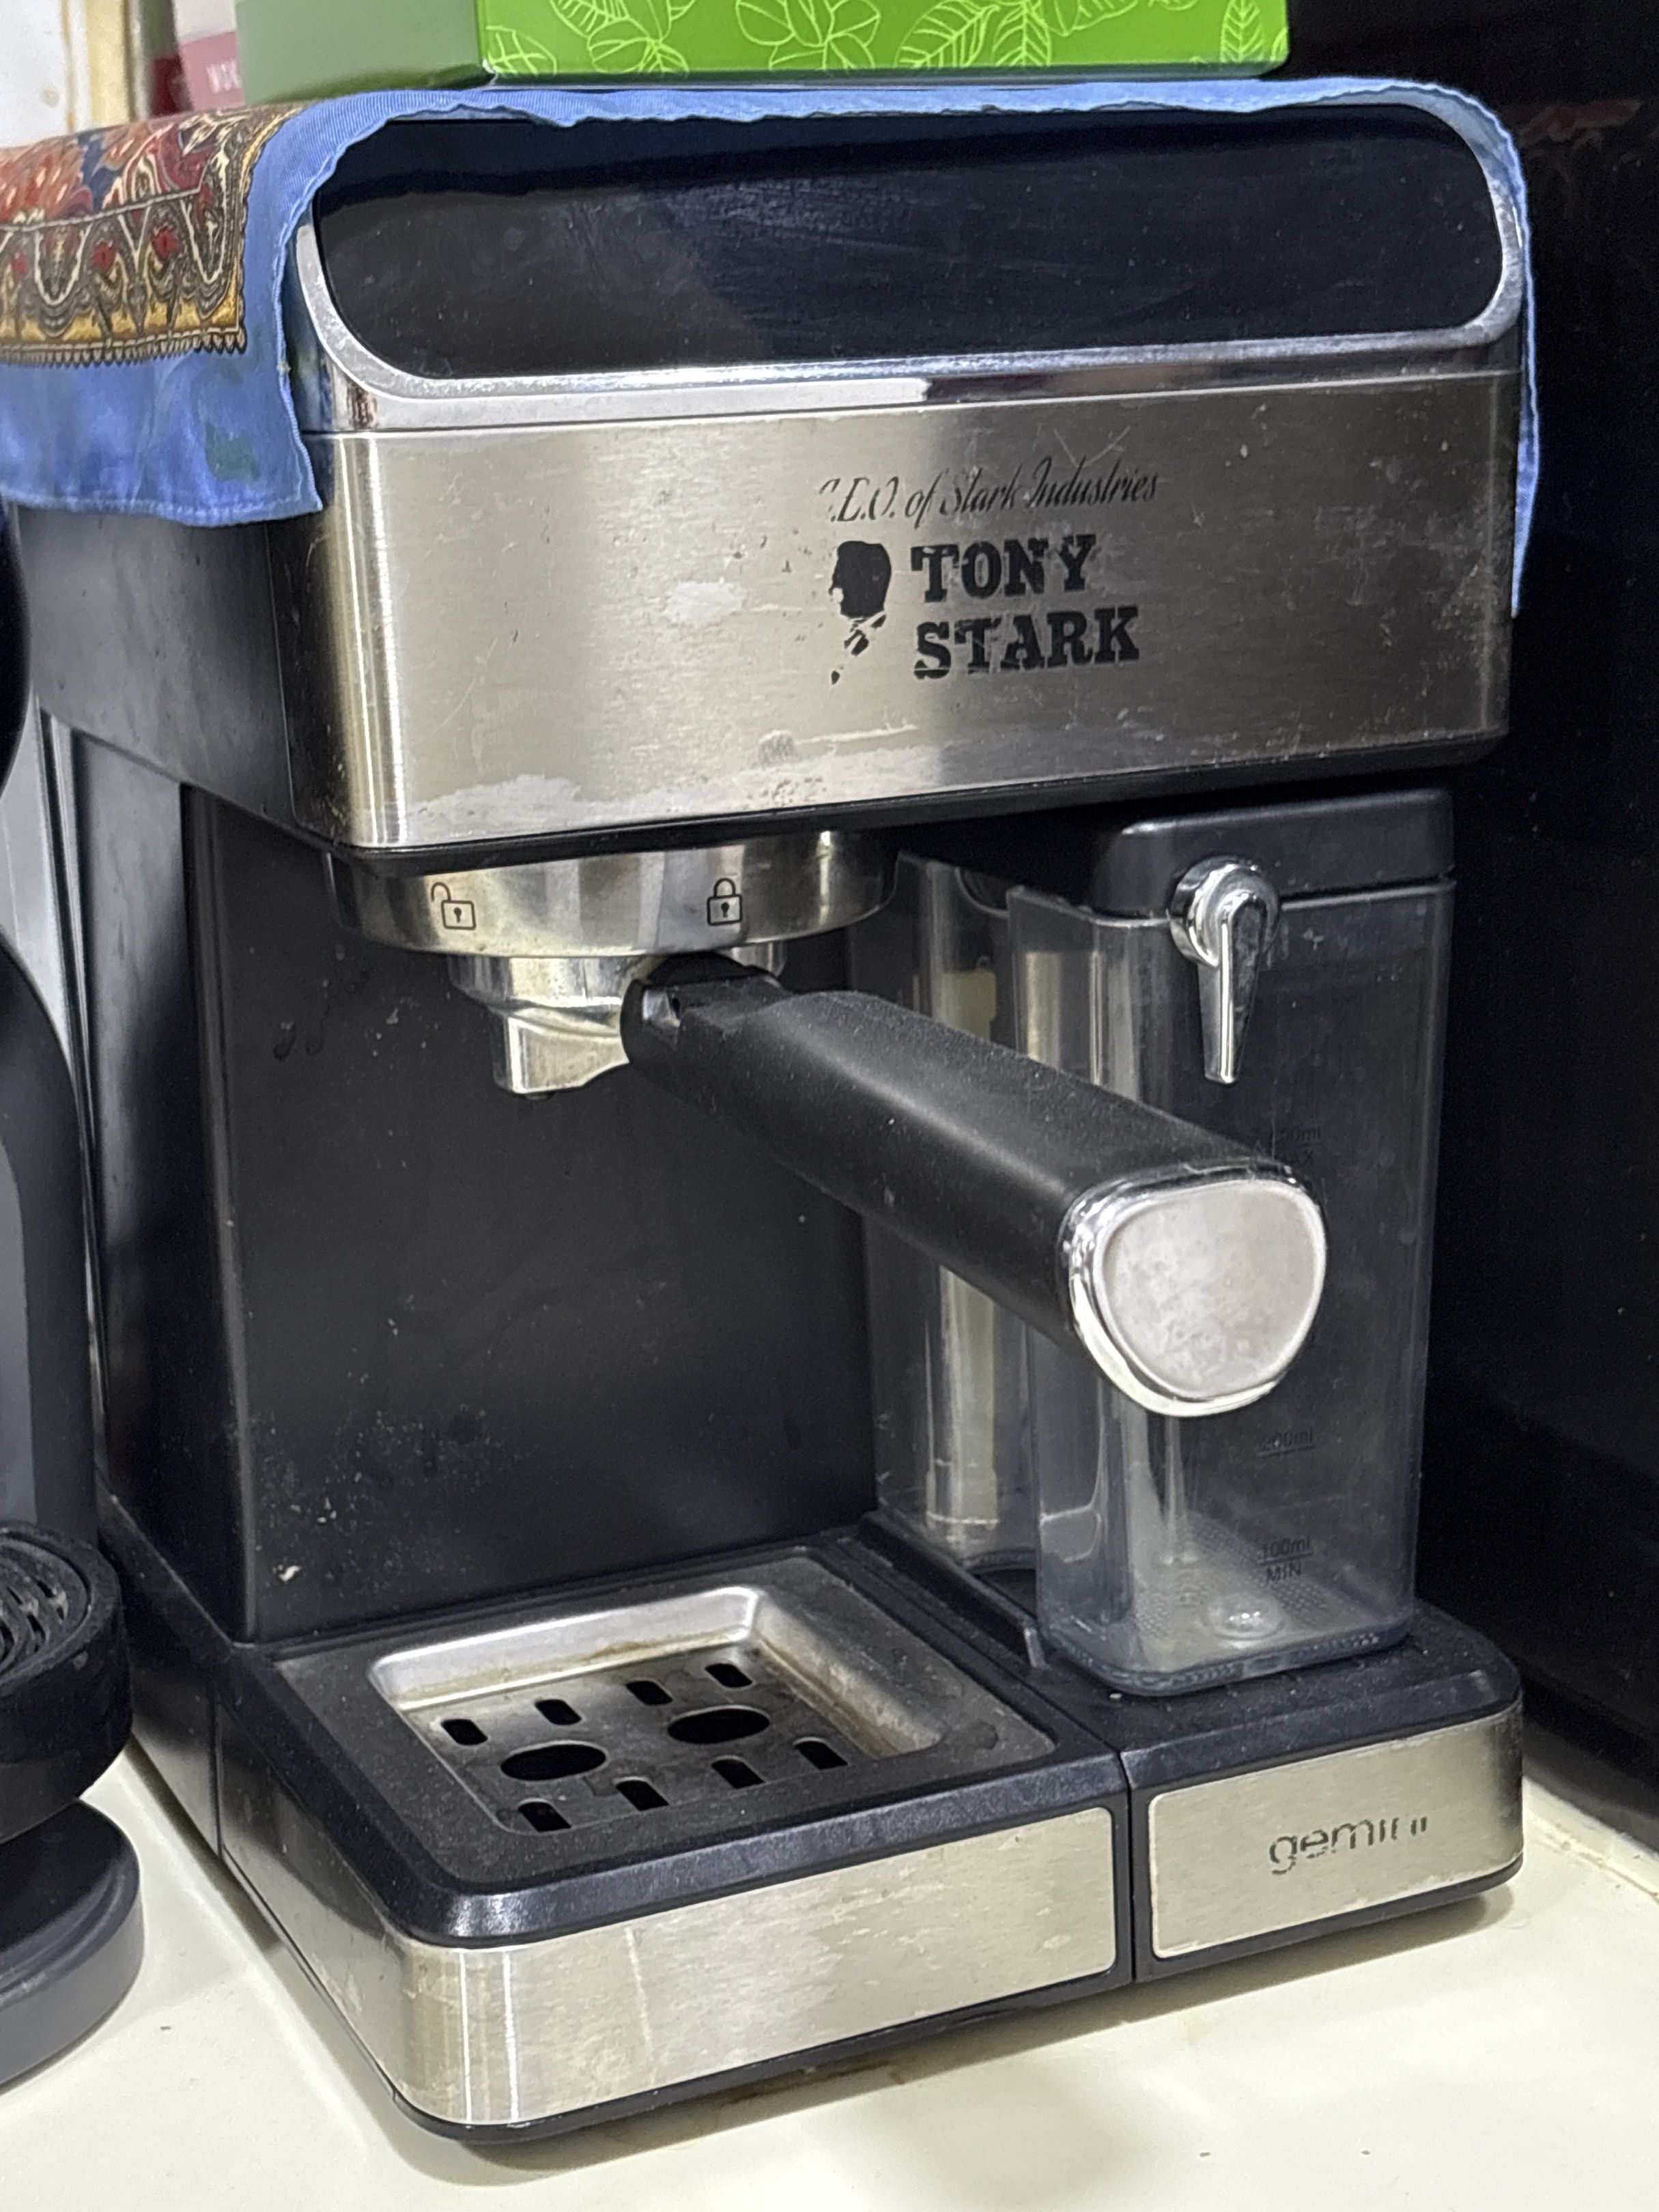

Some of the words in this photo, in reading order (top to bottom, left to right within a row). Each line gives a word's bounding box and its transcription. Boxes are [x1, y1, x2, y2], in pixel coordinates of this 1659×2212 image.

[905, 468, 950, 530] of
[1025, 455, 1159, 509] Industries
[910, 533, 1097, 604] TONY
[913, 605, 1139, 680] STARK
[1261, 1535, 1311, 1558] 100ml
[1265, 1561, 1302, 1582] MIN
